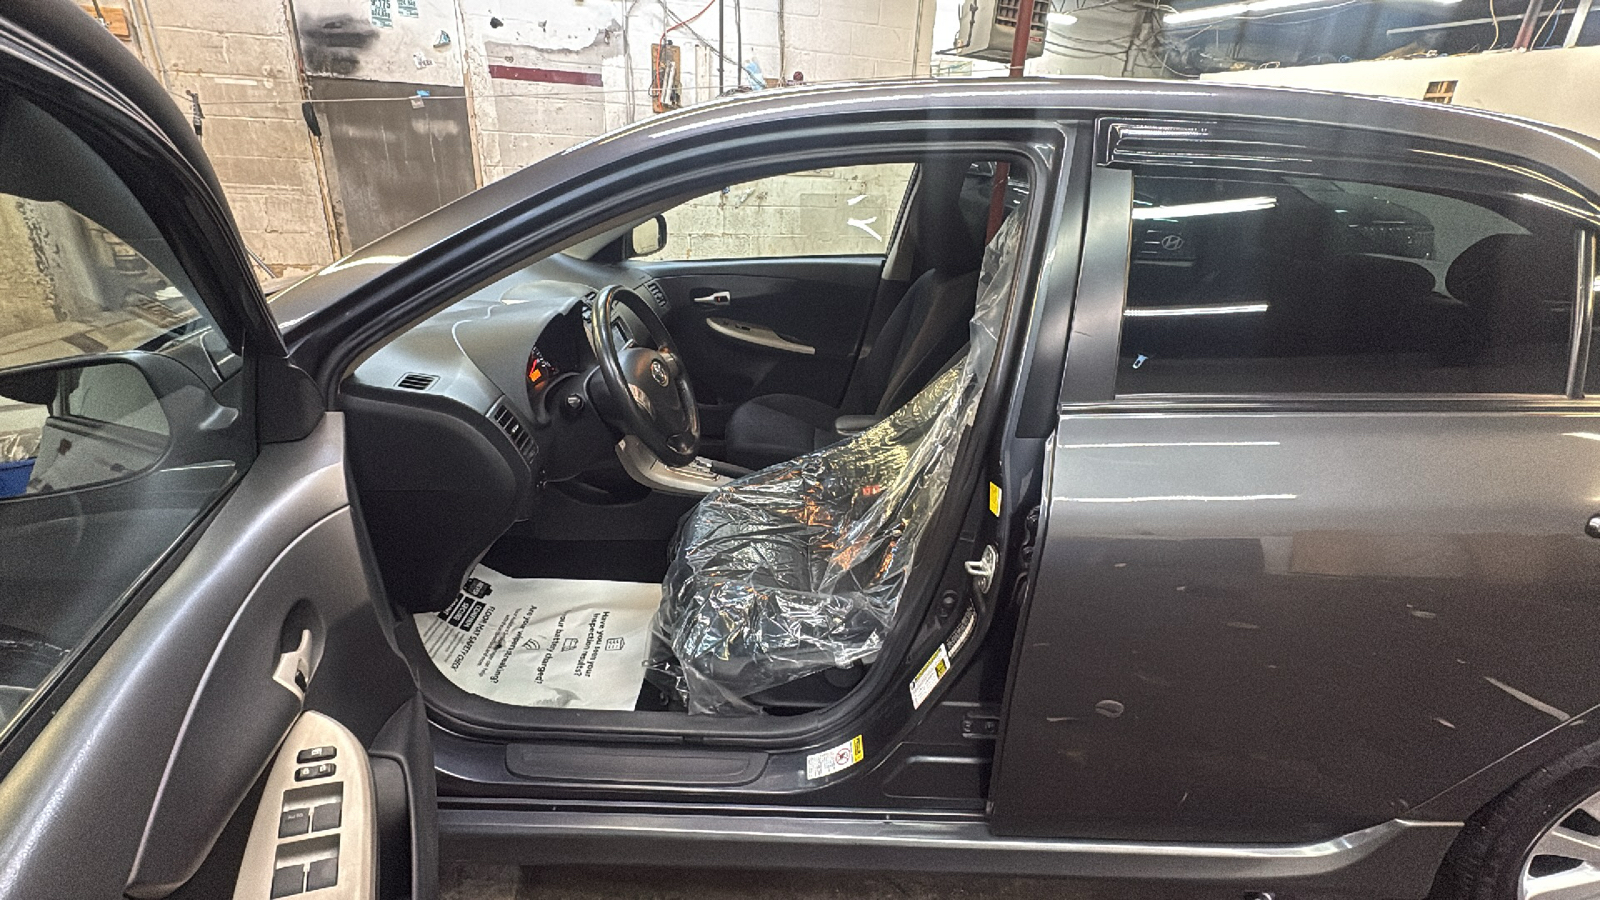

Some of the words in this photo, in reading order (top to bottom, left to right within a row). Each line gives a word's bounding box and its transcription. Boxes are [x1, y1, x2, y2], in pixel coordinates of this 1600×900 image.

[526, 604, 537, 617] Are
[599, 611, 610, 629] Have
[473, 621, 485, 637] MAT
[596, 629, 604, 645] you
[460, 635, 477, 656] SAFETY
[547, 628, 564, 653] battery
[450, 653, 464, 672] CHECK
[584, 660, 594, 677] your
